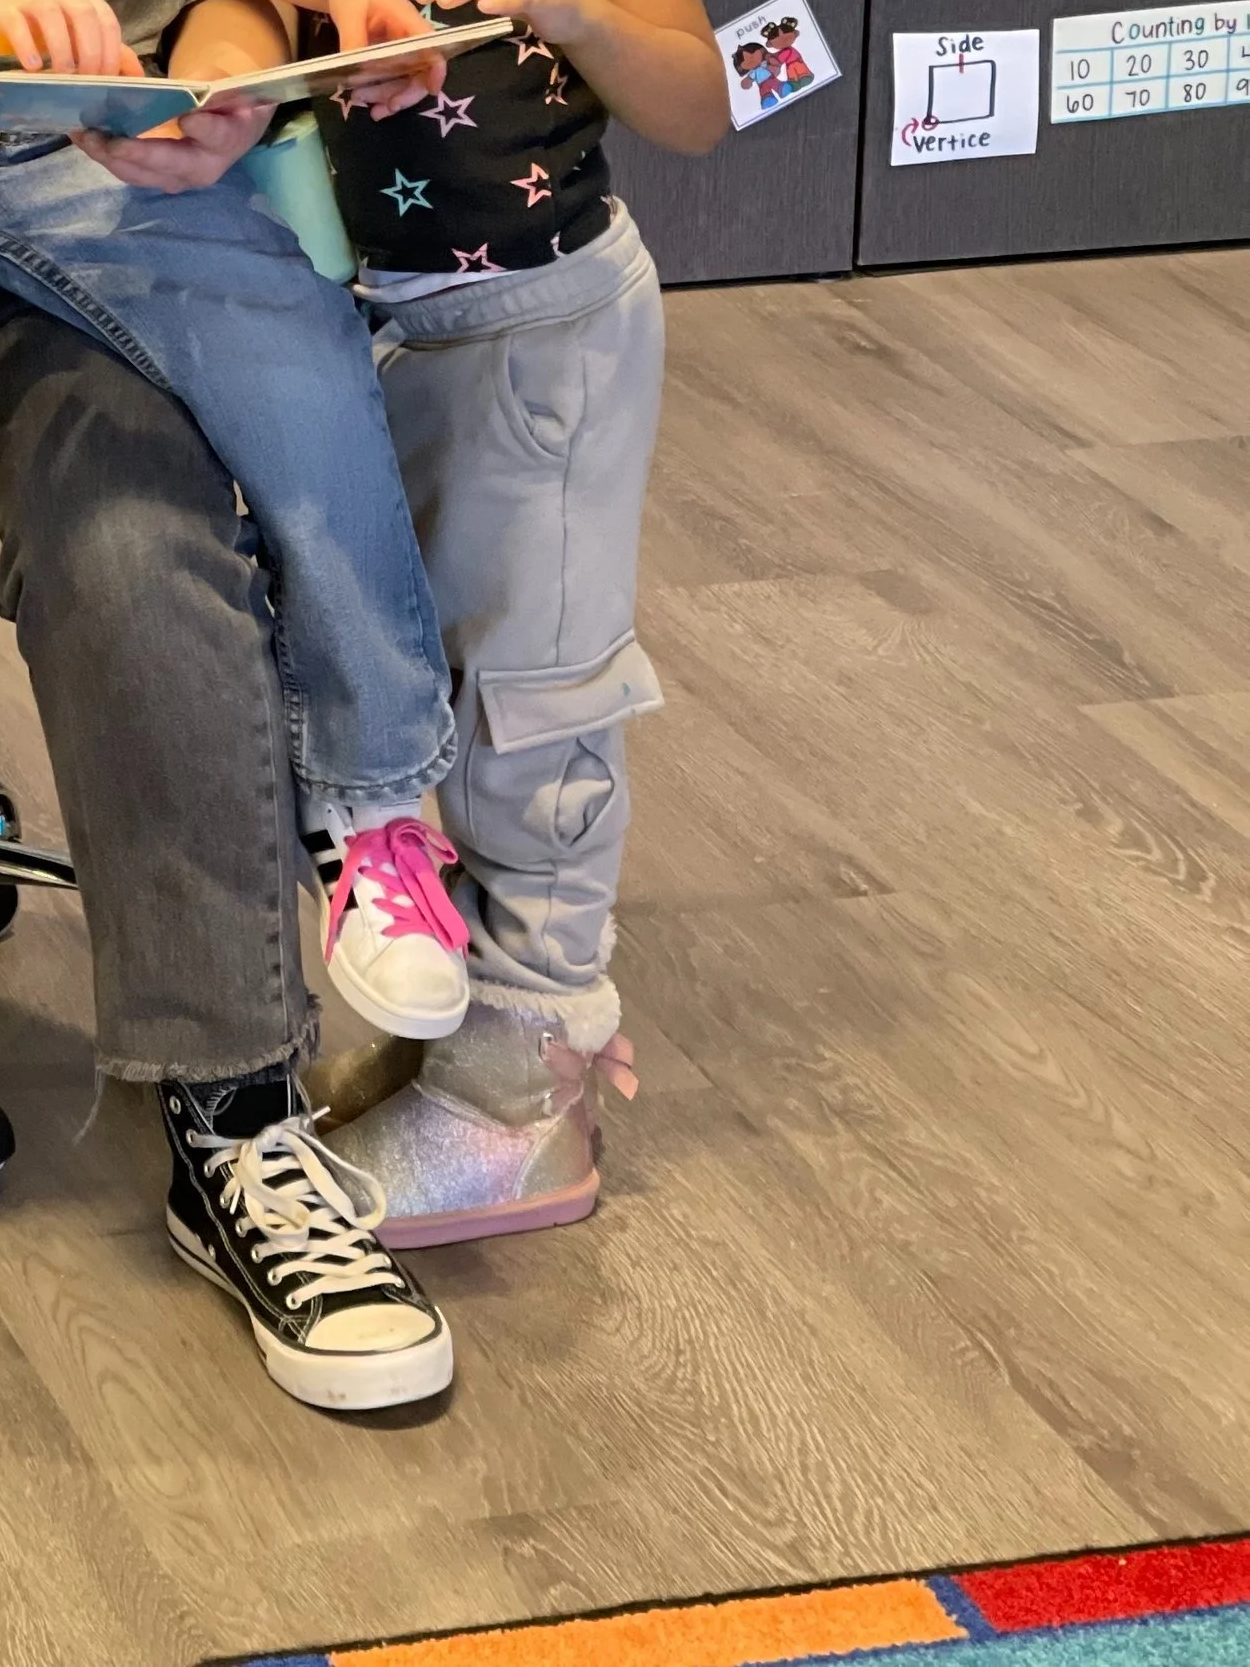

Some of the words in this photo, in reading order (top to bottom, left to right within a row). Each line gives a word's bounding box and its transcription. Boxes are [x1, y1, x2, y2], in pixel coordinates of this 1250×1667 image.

[735, 15, 768, 41] push
[1111, 16, 1205, 45] Counting
[1214, 11, 1237, 34] by
[1069, 58, 1090, 81] 10
[1126, 53, 1152, 77] 20
[1183, 49, 1209, 71] 30
[1066, 93, 1094, 113] 60
[1125, 89, 1151, 108] 70
[1183, 82, 1206, 103] 80
[912, 131, 991, 153] vertice
